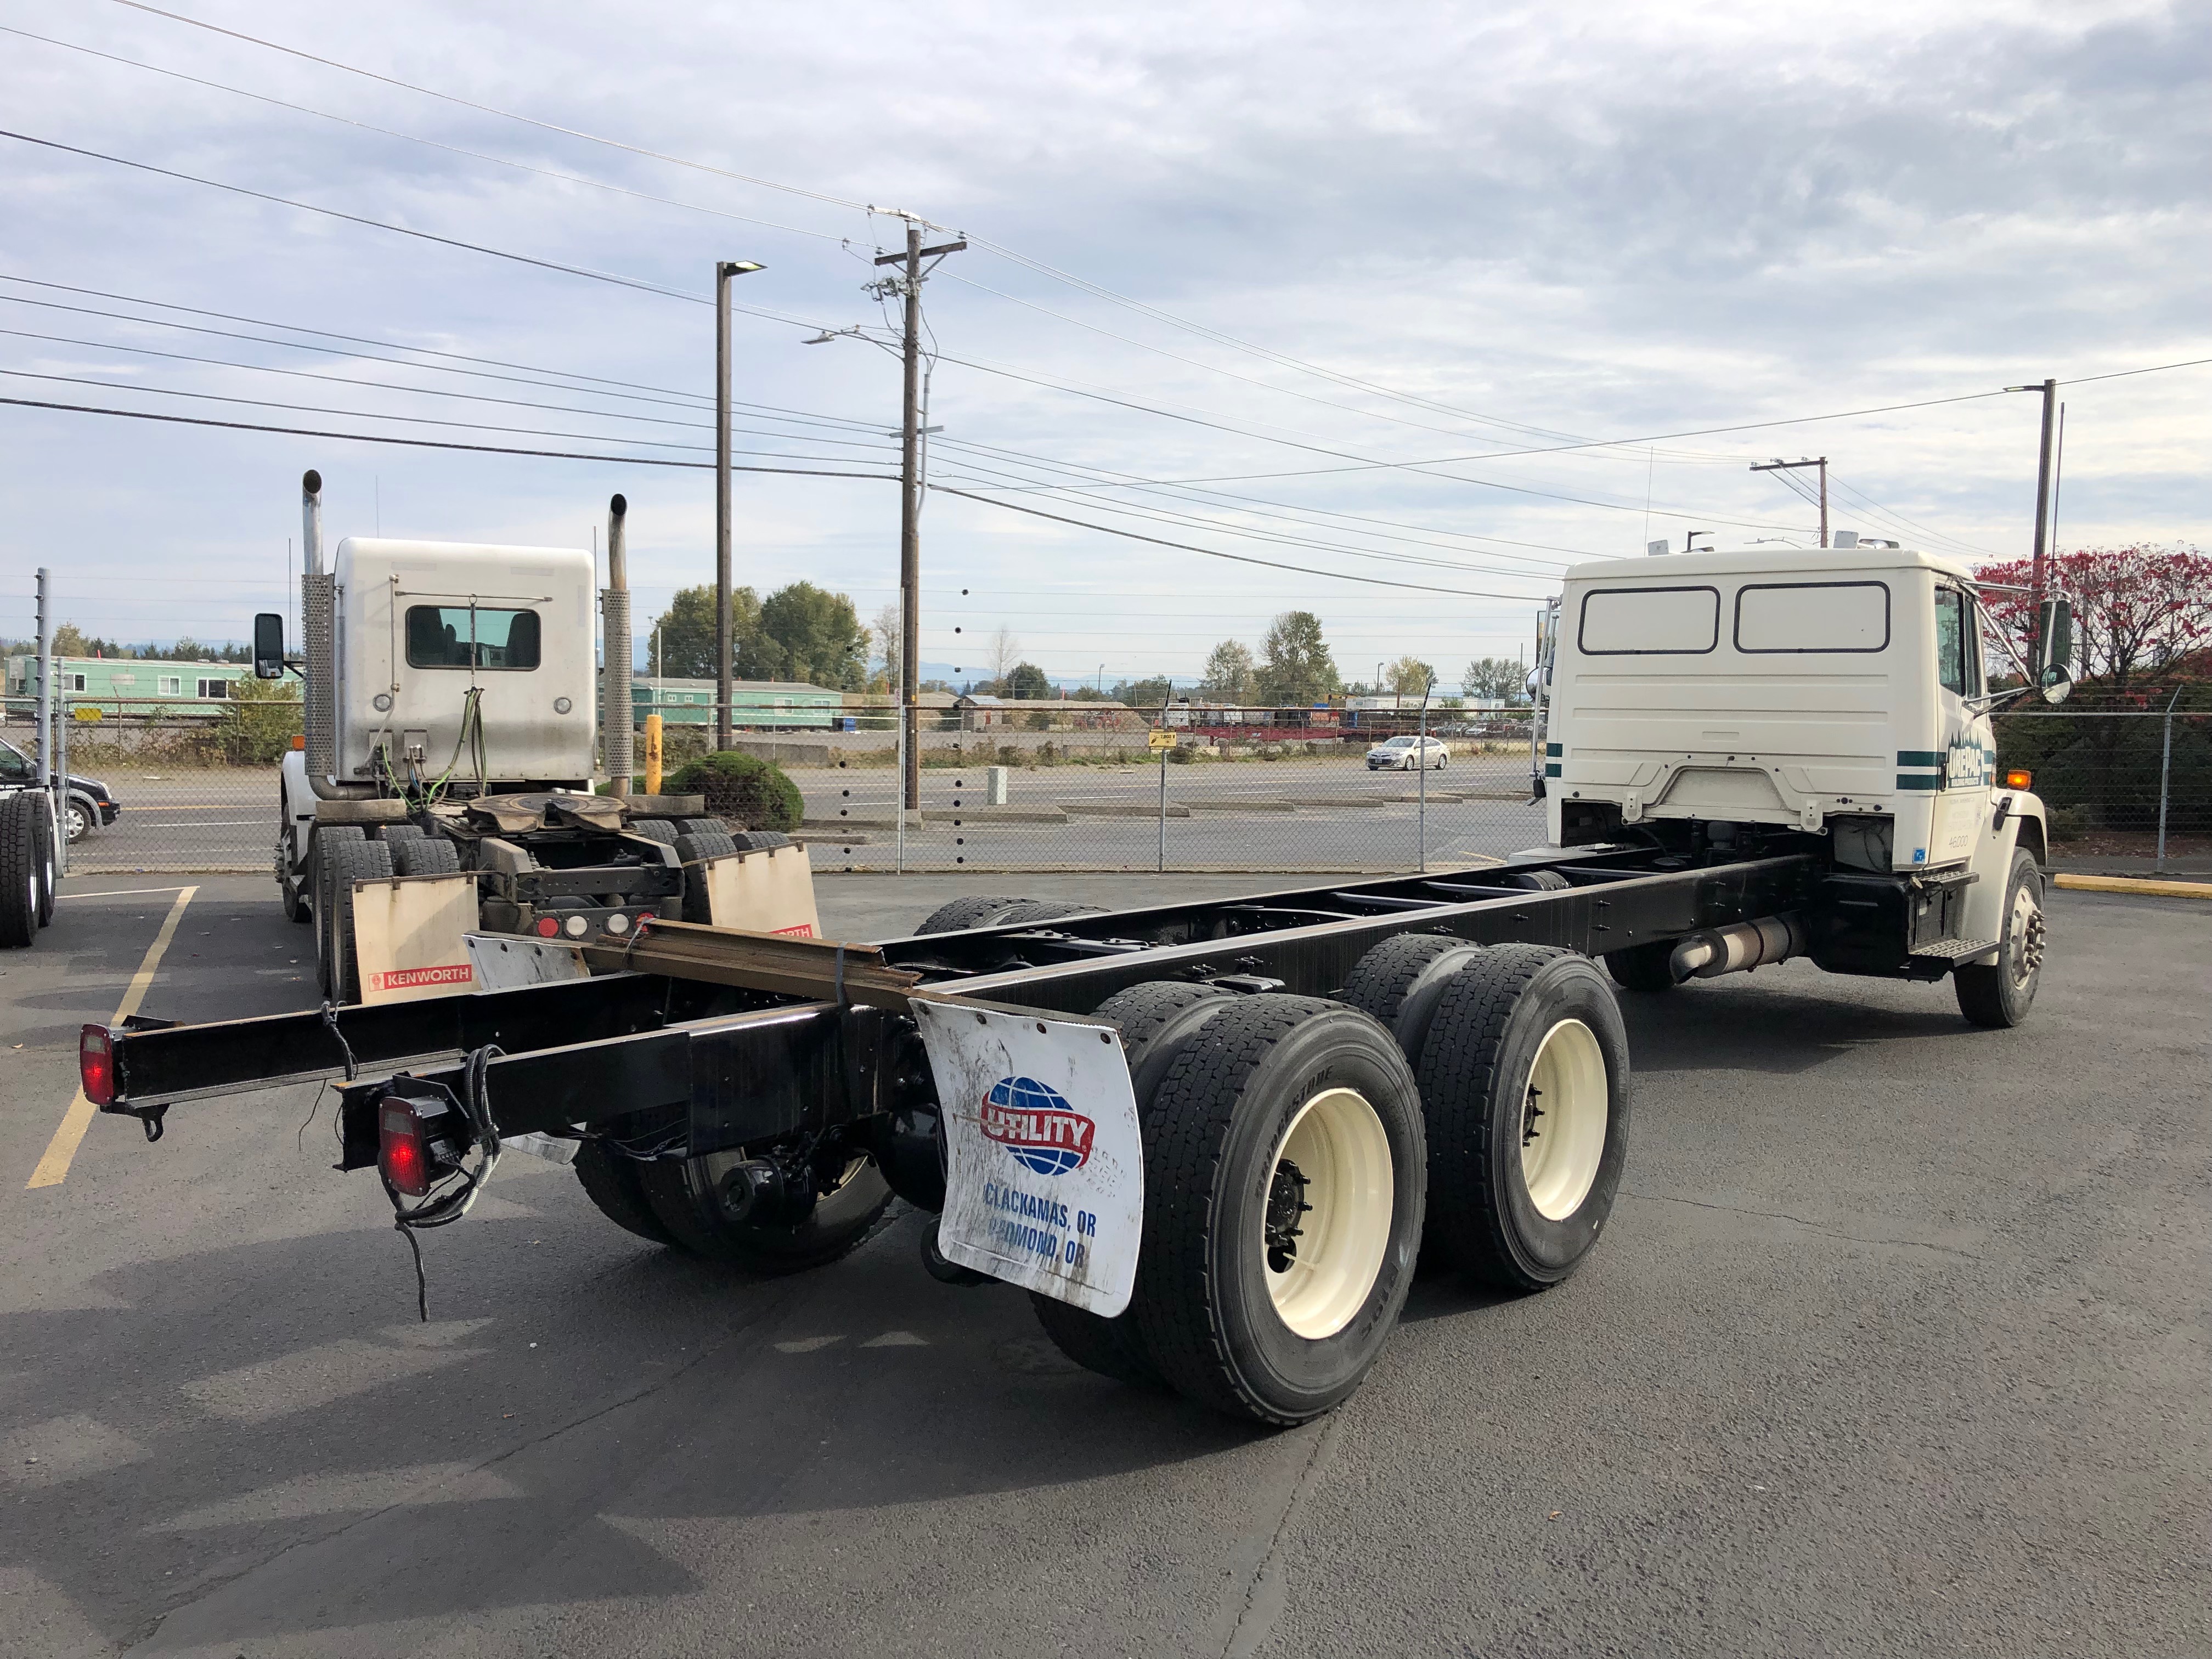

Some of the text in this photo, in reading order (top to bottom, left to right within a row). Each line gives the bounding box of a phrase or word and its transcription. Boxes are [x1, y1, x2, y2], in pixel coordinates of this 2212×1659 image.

[388, 968, 469, 986] KENWORTH
[988, 1107, 1088, 1147] UTILITY
[984, 1183, 1096, 1238] CLACKAMAS, OR
[1065, 1240, 1085, 1268] OR
